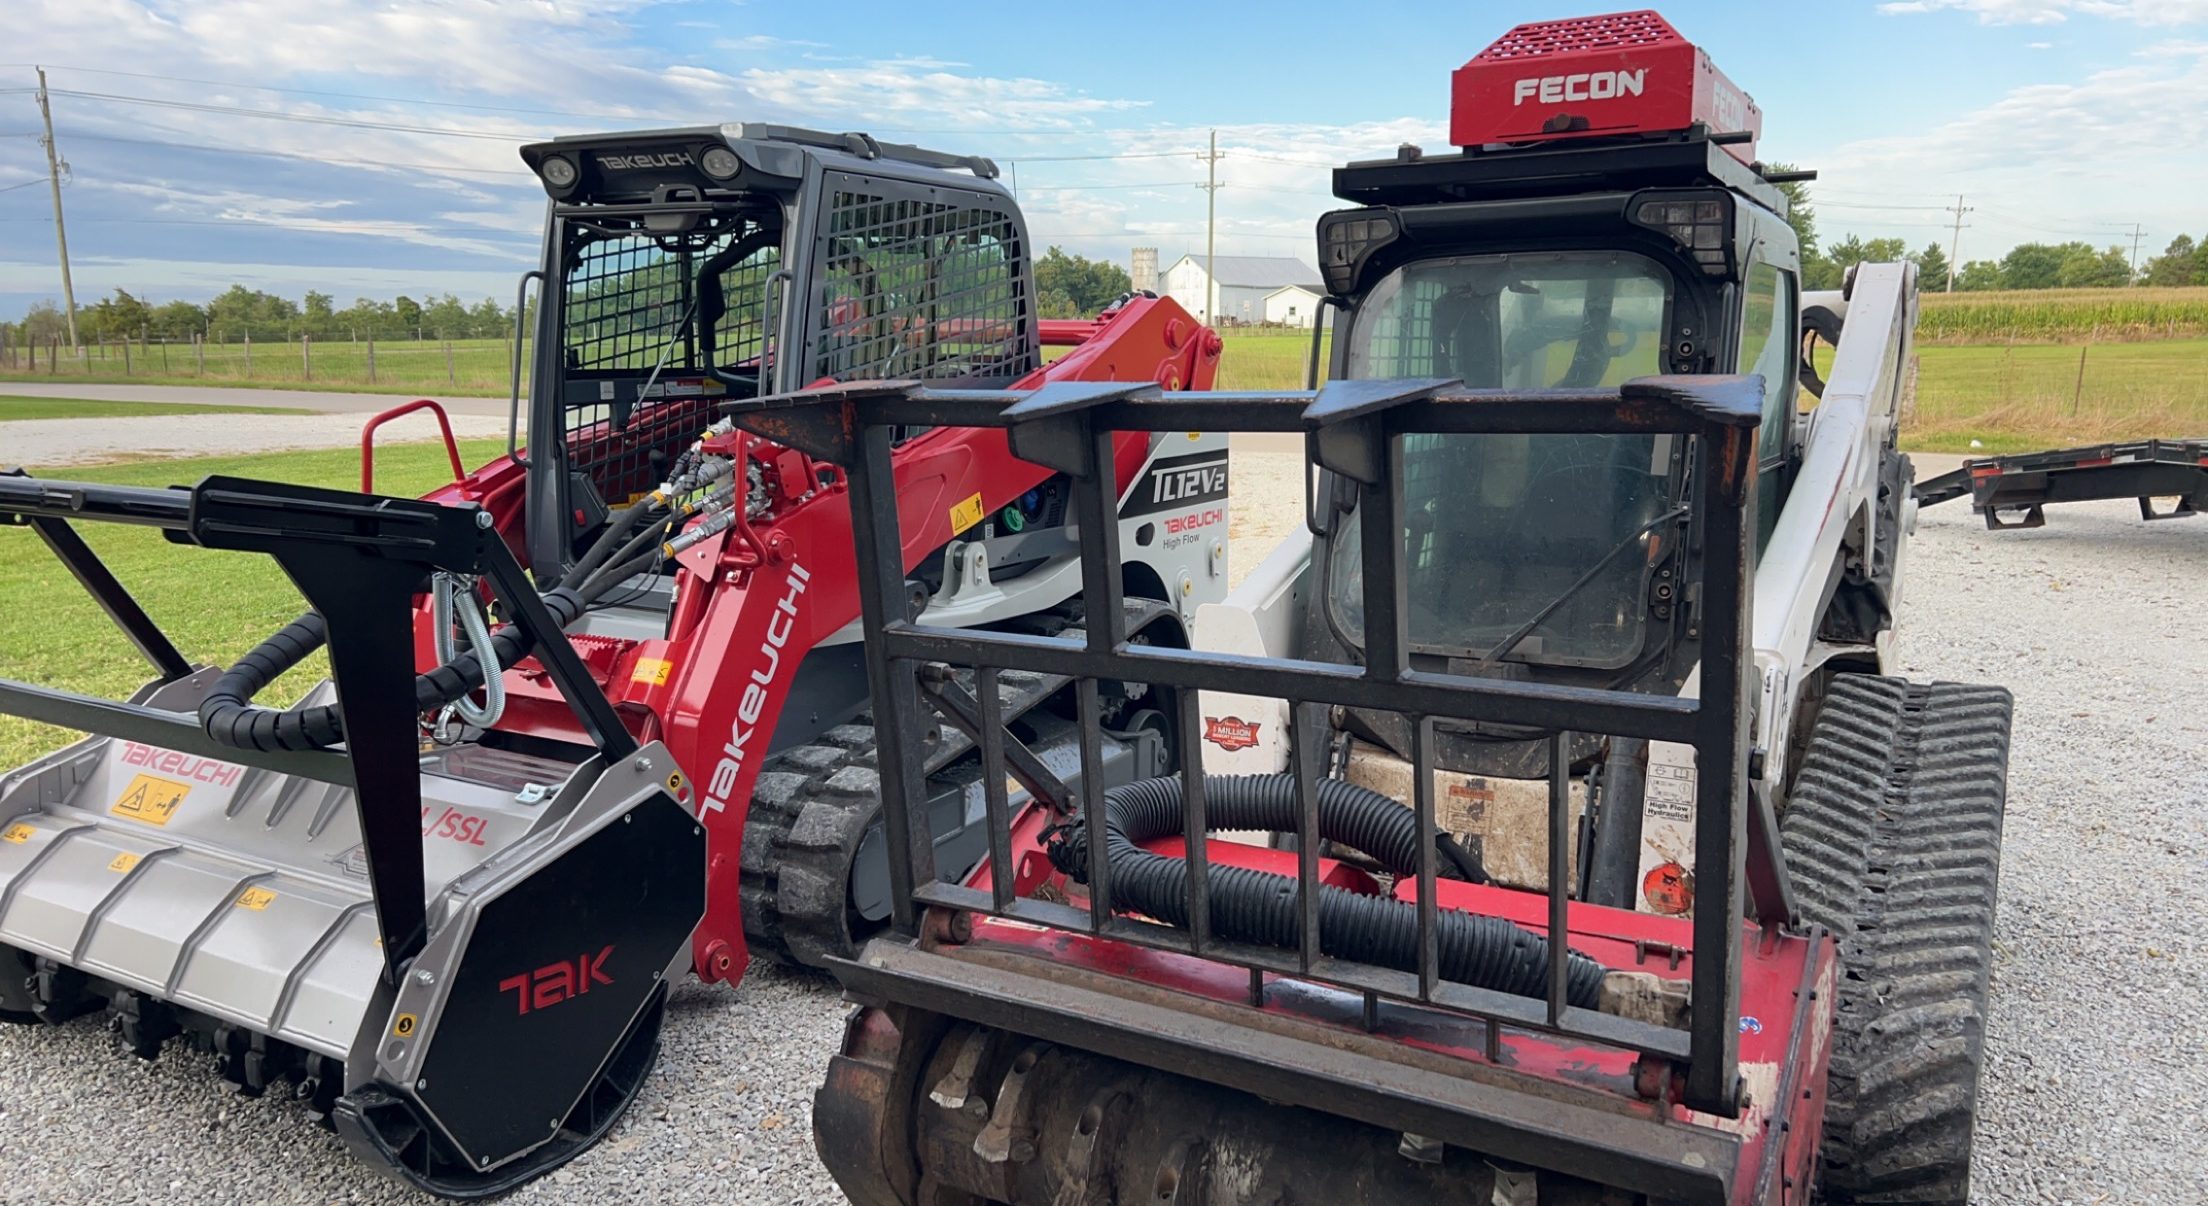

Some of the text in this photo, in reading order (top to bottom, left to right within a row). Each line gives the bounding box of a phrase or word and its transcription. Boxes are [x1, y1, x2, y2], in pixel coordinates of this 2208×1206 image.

[1513, 69, 1645, 106] FECON
[596, 152, 695, 169] TAKEUCH
[1151, 459, 1228, 503] TL12V2
[1164, 508, 1223, 534] TAKEUCHI
[1163, 533, 1200, 550] High Flow
[698, 562, 811, 823] TAKEUCHI
[1217, 726, 1251, 737] MILLION
[121, 741, 242, 787] TAKEUCHI
[1647, 807, 1689, 819] Hydraulics
[1649, 801, 1689, 812] High Flow
[499, 944, 616, 1016] TAK
